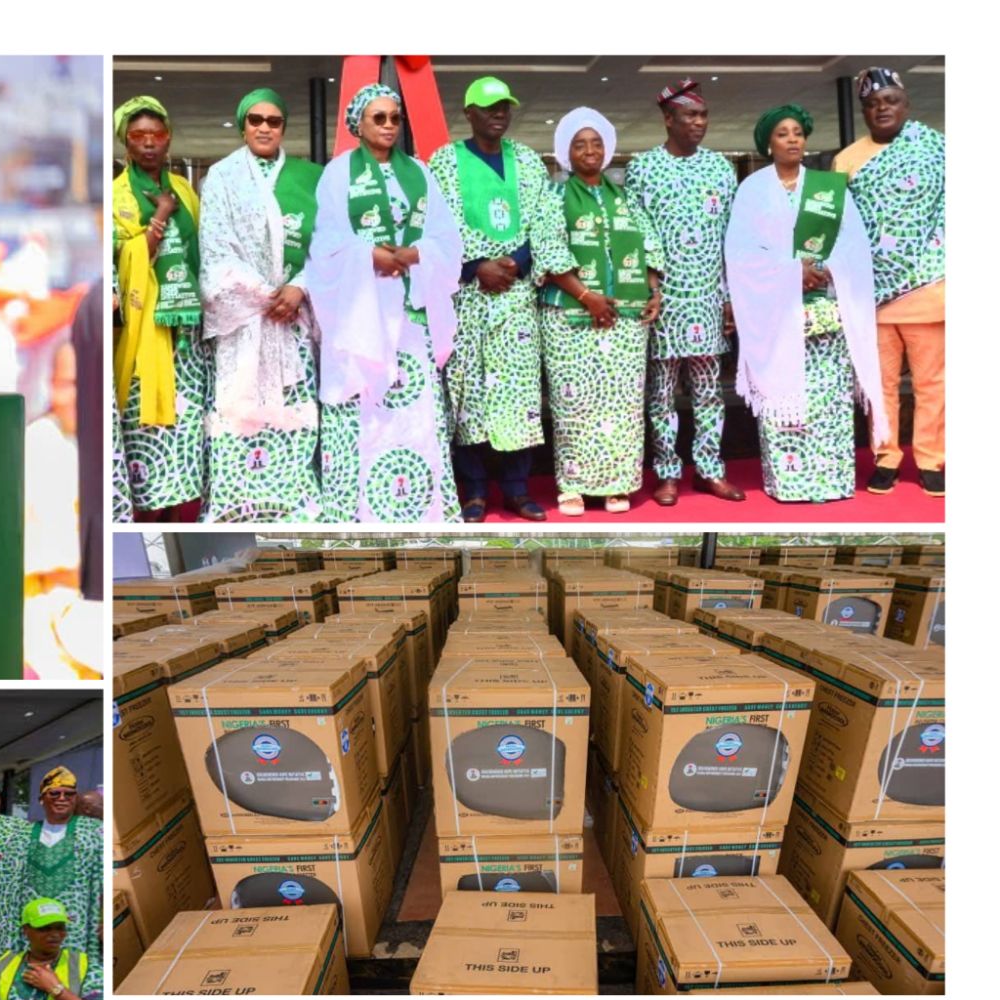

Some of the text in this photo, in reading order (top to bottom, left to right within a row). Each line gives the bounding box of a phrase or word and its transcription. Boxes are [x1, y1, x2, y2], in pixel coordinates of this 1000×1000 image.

[749, 714, 770, 723] FIRST
[269, 719, 290, 729] FIRST
[524, 719, 546, 729] FIRST
[296, 864, 316, 872] FIRST
[523, 864, 543, 872] FIRST
[716, 938, 797, 949] THIS SIDE UP
[465, 963, 551, 974] THIS SIDE UP
[234, 986, 256, 995] UP
